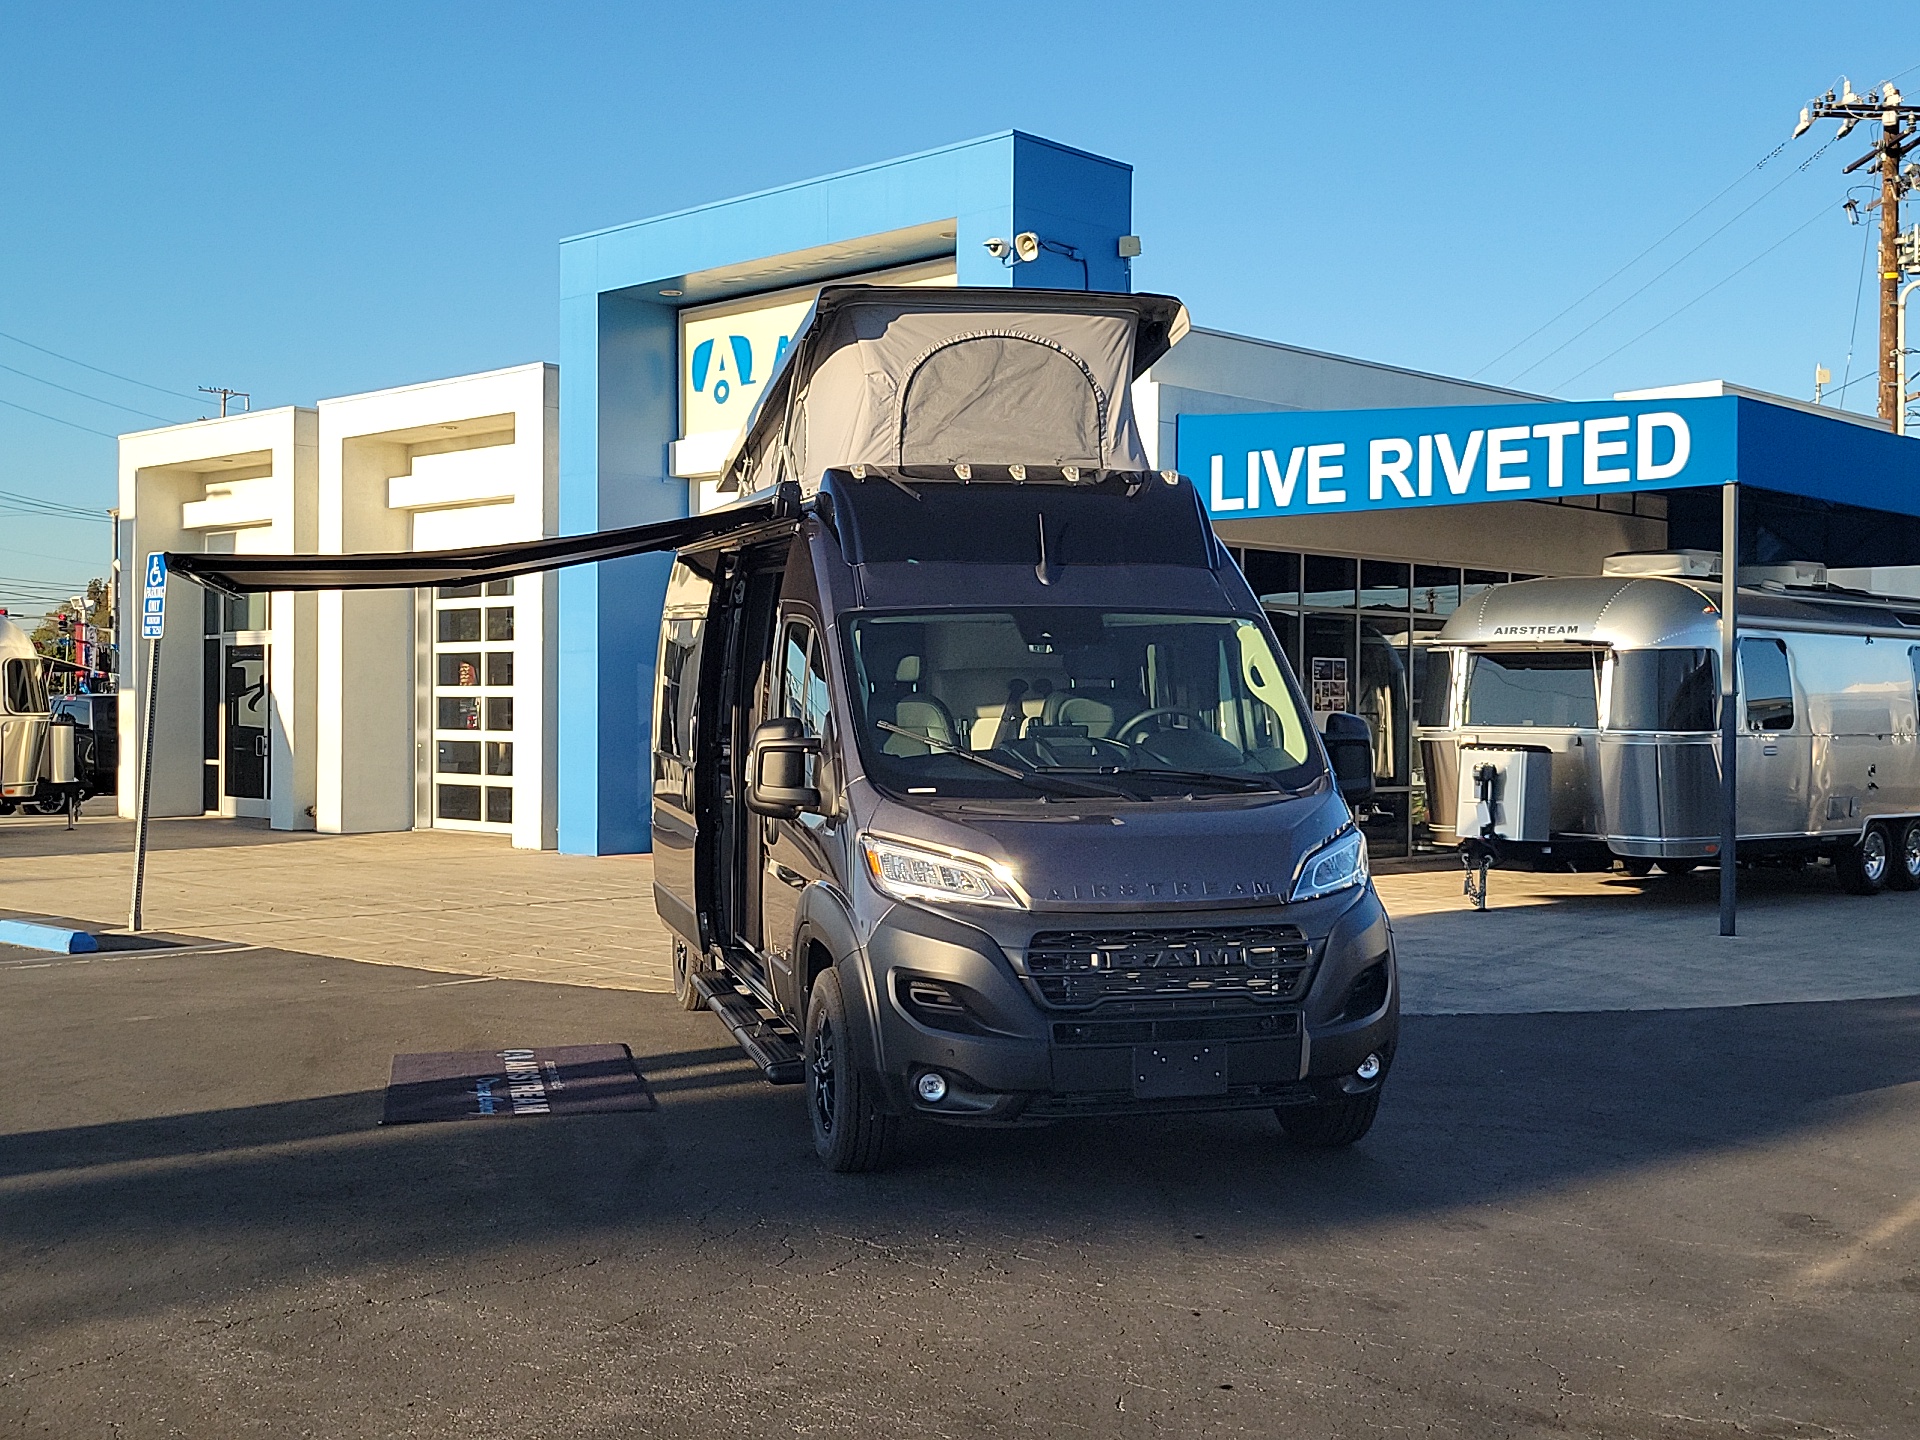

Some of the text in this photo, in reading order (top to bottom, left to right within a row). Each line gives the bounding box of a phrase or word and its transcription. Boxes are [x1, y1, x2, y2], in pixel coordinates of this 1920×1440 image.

[1210, 411, 1691, 512] LIVE RIVETED
[1494, 625, 1579, 635] AIRSTREAM
[1045, 881, 1272, 900] AIRSTREAM
[1105, 949, 1247, 968] RAM
[504, 1061, 551, 1114] AIRSTREAM
